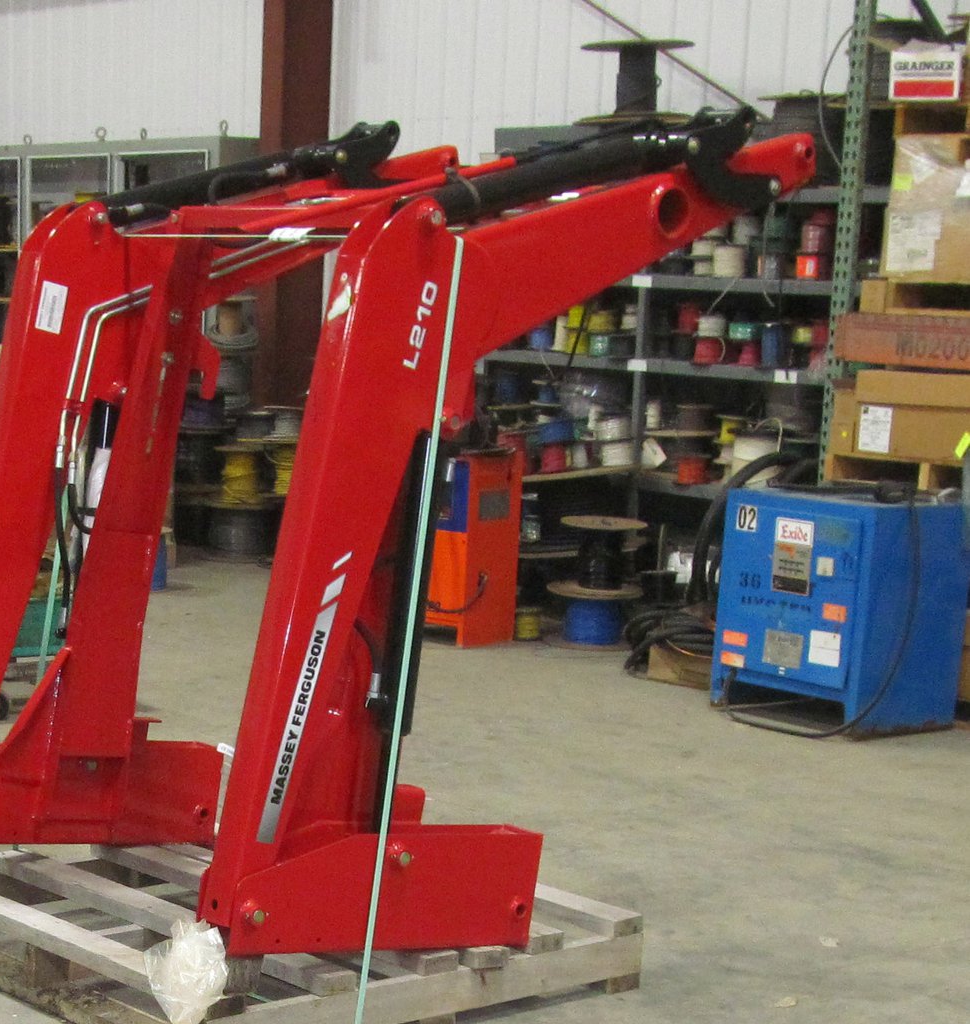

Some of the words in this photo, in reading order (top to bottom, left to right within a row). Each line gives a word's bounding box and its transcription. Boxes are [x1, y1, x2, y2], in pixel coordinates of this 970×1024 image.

[894, 60, 955, 72] GRAINGER
[402, 280, 438, 370] L210
[738, 505, 756, 530] 02
[780, 523, 809, 542] Exide
[270, 730, 299, 805] MASSEY
[291, 629, 326, 727] FERGUSON
